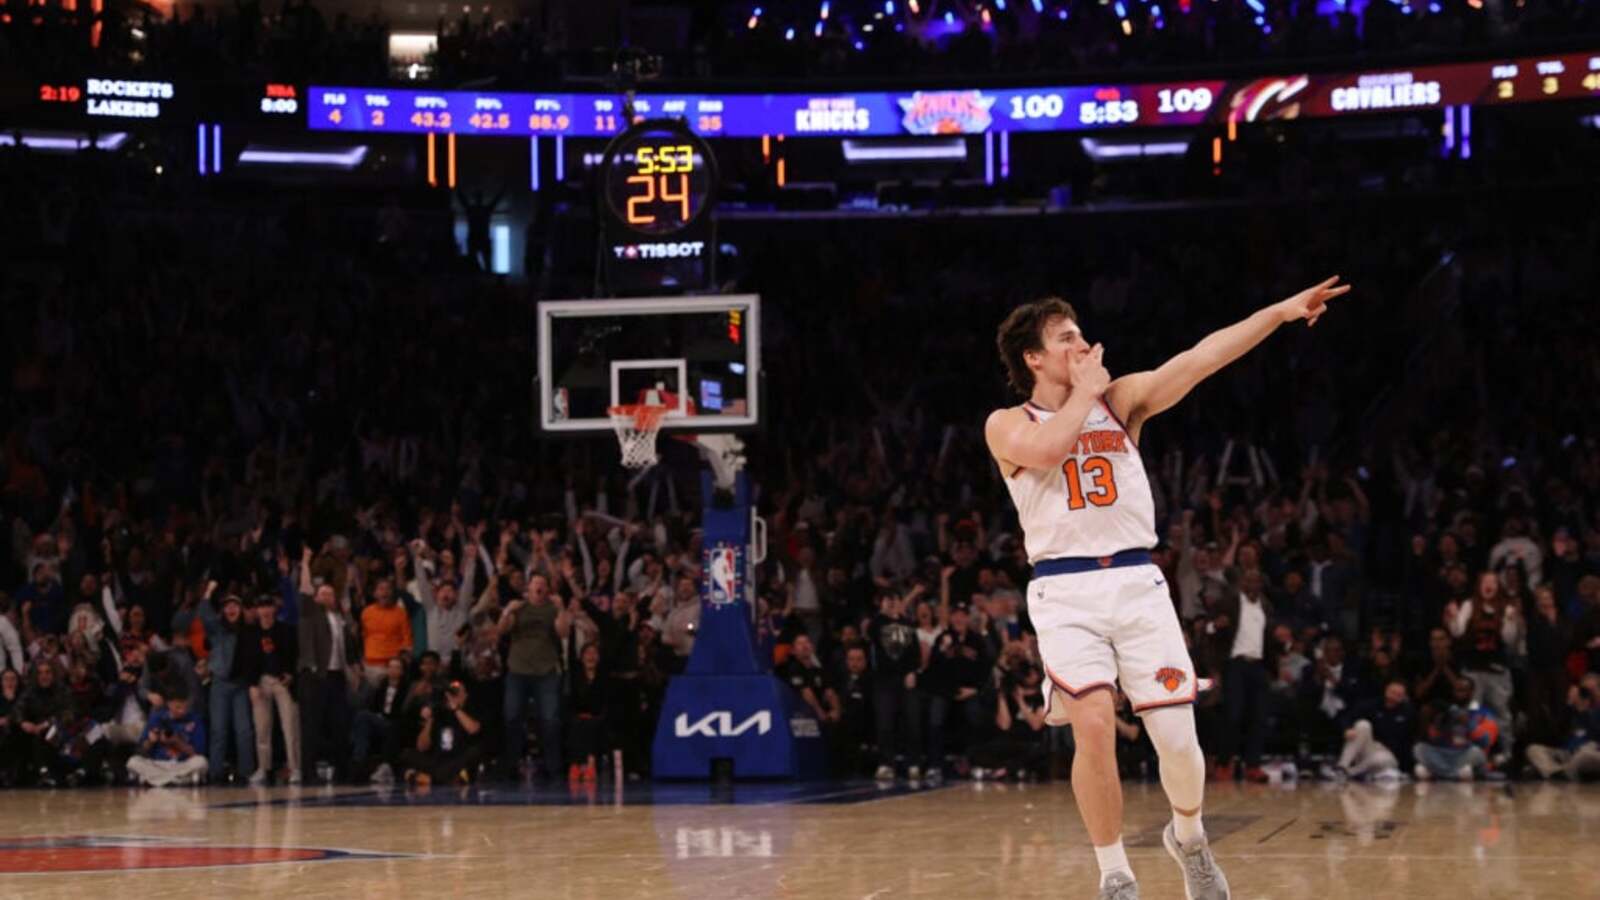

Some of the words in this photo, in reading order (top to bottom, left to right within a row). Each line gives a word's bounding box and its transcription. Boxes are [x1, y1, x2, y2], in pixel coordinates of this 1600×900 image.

[87, 79, 174, 98] ROCKETS
[1157, 87, 1213, 113] 109
[1331, 81, 1441, 111] CAVALIERS
[87, 99, 160, 118] LAKERS
[1009, 94, 1063, 119] 100
[1079, 100, 1139, 124] 5:53
[328, 109, 342, 124] 4
[410, 111, 452, 128] 43.2
[595, 115, 616, 131] 11
[795, 108, 870, 132] KNICKS
[637, 145, 693, 174] 5:53
[626, 174, 690, 224] 24
[639, 242, 704, 258] TISSOT
[1062, 456, 1118, 510] 13
[674, 710, 772, 737] KIA
